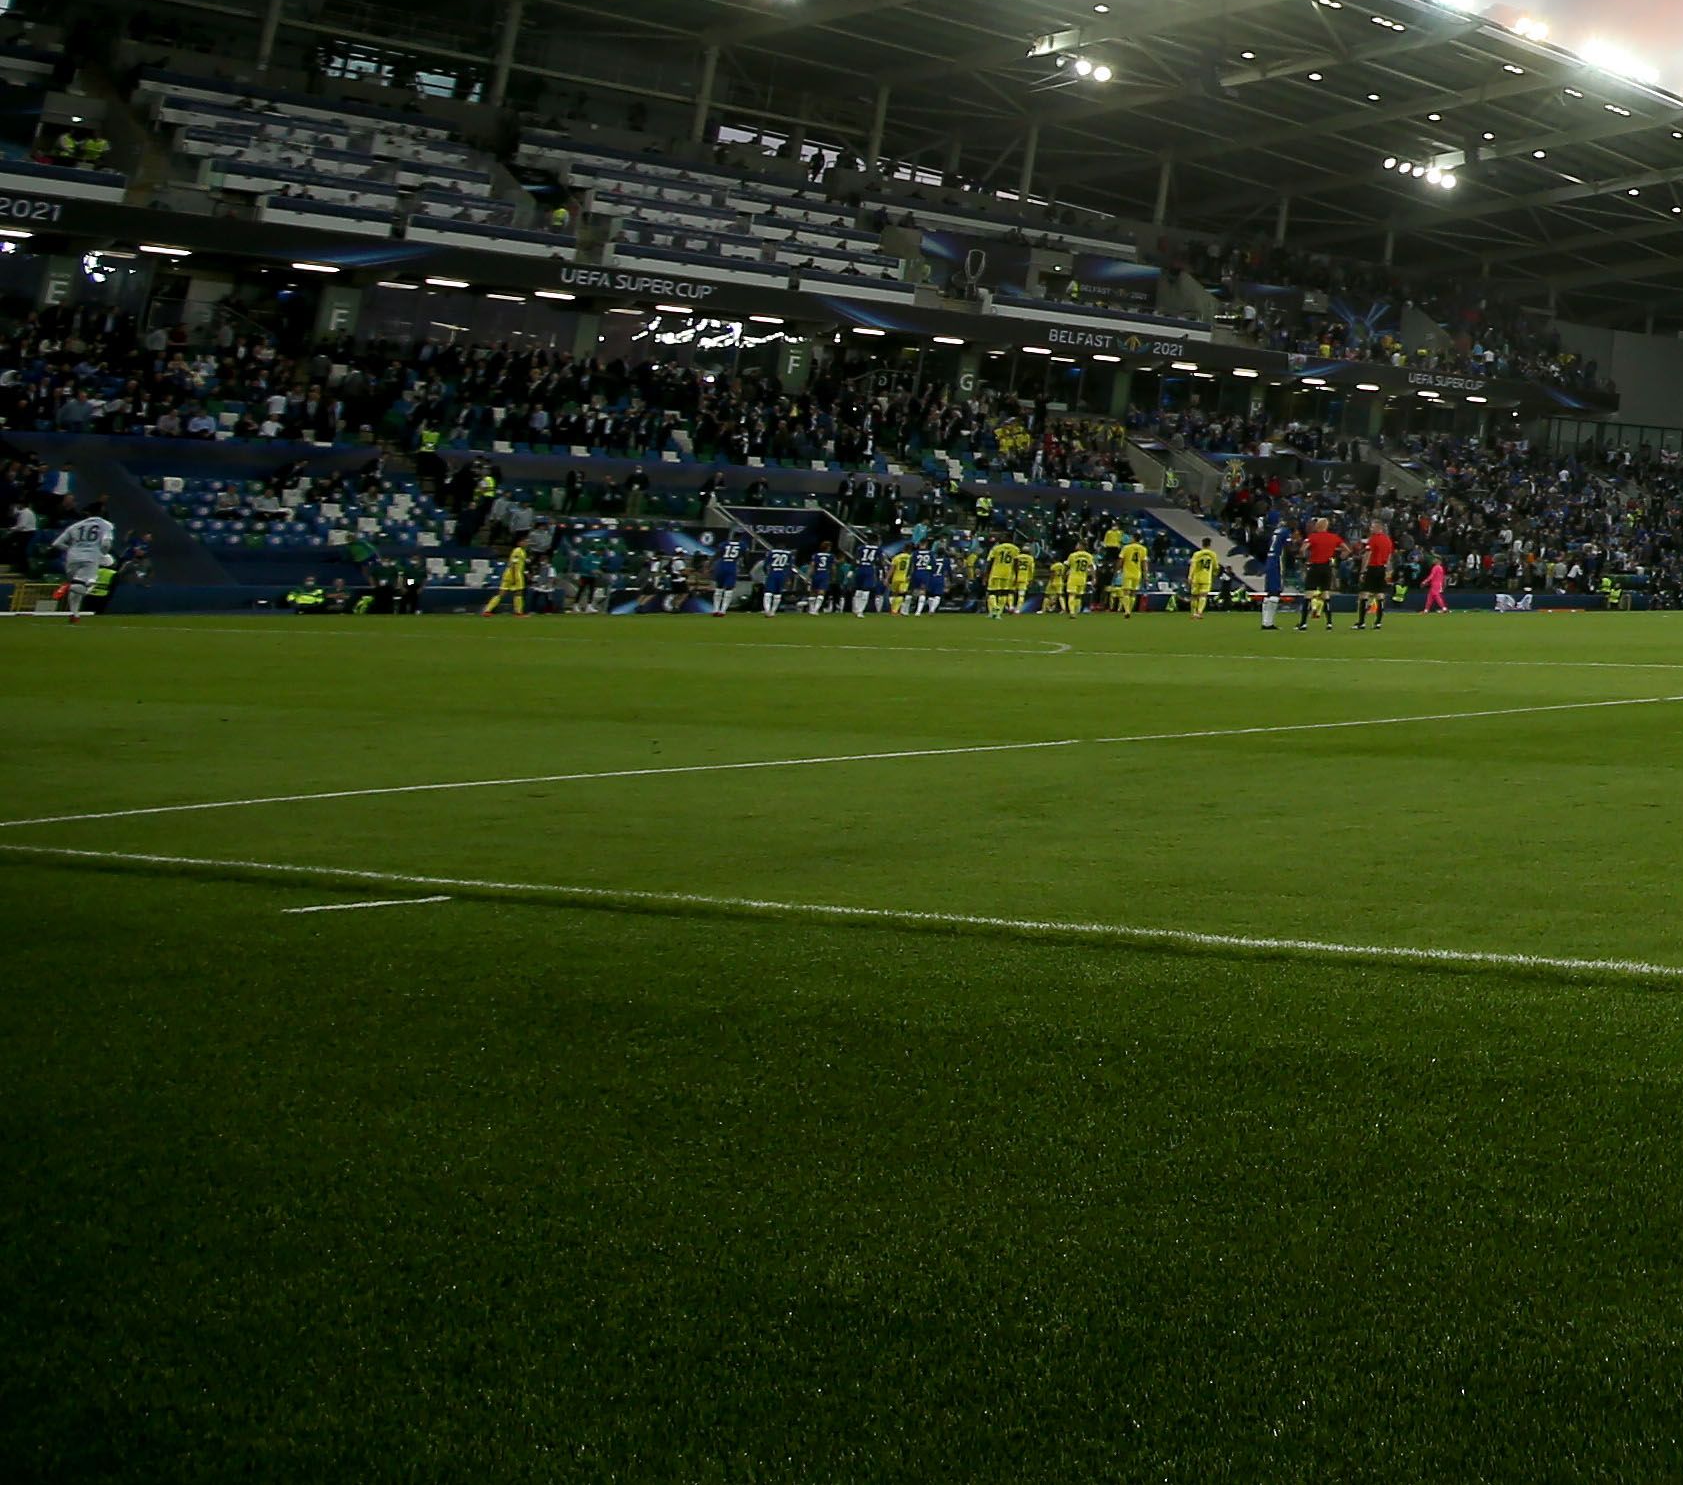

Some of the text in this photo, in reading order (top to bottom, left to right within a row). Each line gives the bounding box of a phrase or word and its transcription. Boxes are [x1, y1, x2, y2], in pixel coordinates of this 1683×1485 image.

[0, 197, 63, 222] 2021
[561, 268, 713, 300] UEFA SUPER CUP
[1049, 328, 1183, 356] BELFAST 2021
[960, 373, 975, 391] G
[1408, 372, 1486, 391] UEFA SUPER CUP
[77, 525, 99, 542] 16
[723, 545, 741, 558] 15
[861, 548, 878, 563] 14
[1000, 550, 1013, 564] 16
[771, 553, 788, 567] 20
[819, 556, 828, 568] 3
[916, 554, 931, 567] 29
[935, 562, 944, 576] 7
